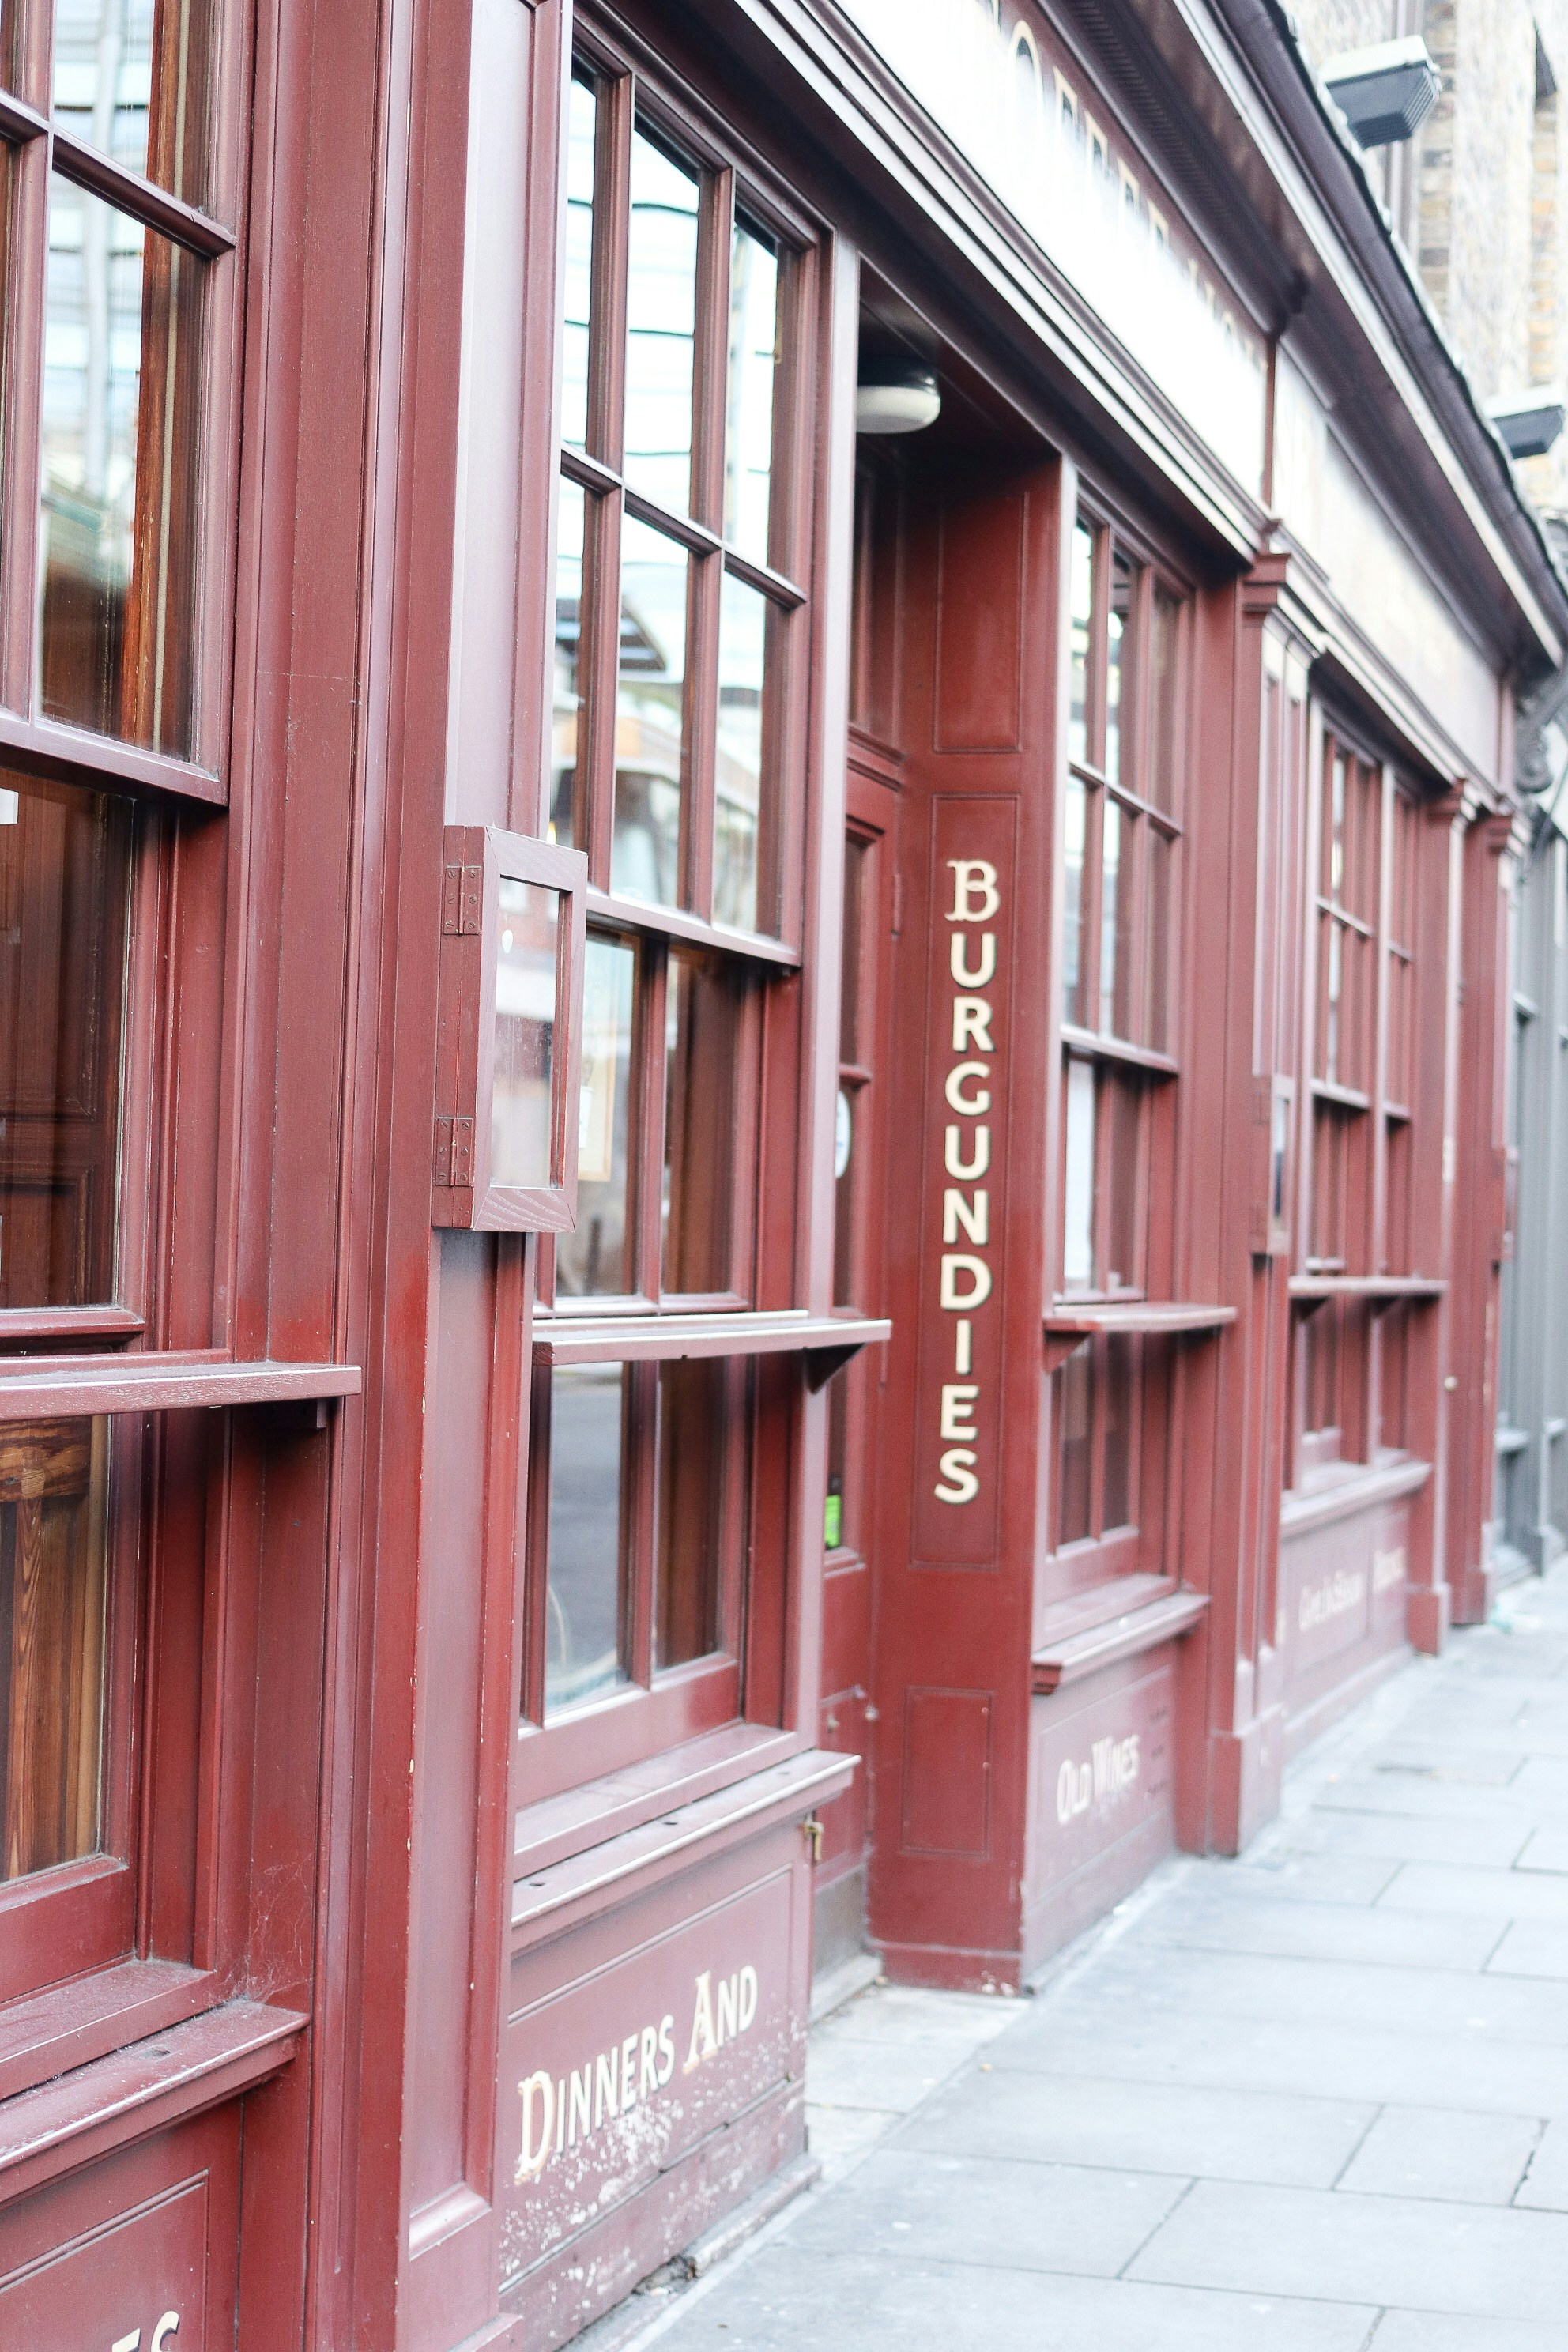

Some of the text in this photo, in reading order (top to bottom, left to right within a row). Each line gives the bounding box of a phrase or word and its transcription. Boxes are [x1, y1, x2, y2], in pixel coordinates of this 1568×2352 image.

[934, 859, 1001, 1505] BURGUNDIES
[1057, 1758, 1092, 1825] OLD
[514, 1965, 759, 2186] DINNERS AND
